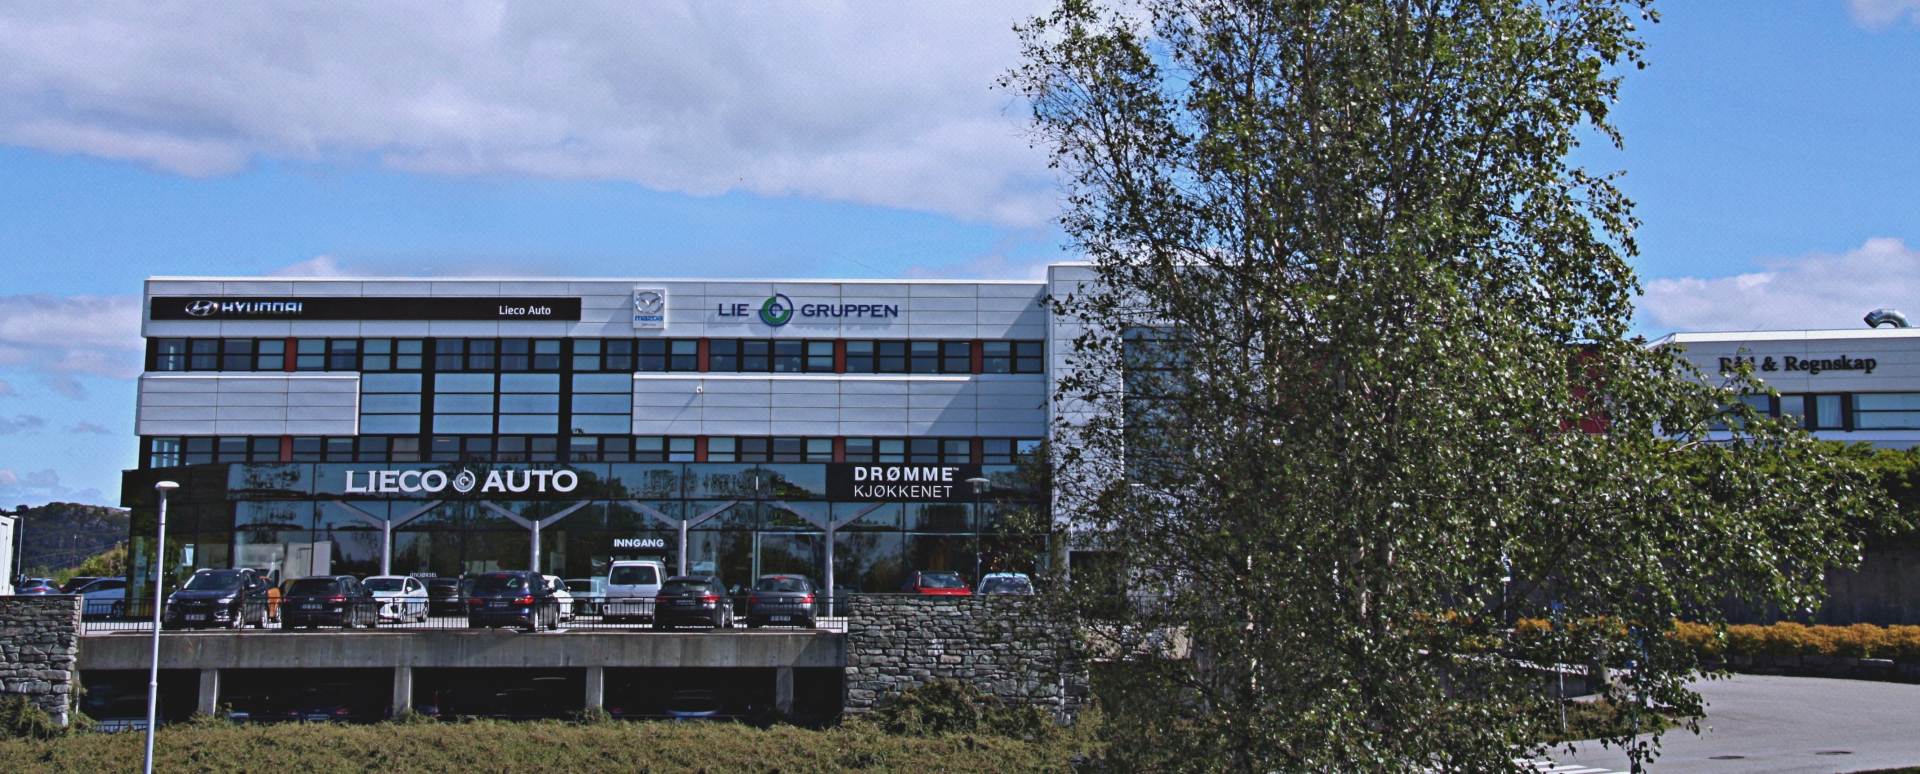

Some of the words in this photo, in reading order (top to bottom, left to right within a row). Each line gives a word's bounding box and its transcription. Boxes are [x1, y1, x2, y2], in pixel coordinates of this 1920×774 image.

[499, 305, 526, 315] Lieco
[527, 305, 552, 315] Auto
[718, 303, 749, 317] LIE
[801, 303, 899, 318] GRUPPEN
[1761, 356, 1778, 372] &
[1784, 354, 1877, 375] Regnskap
[345, 469, 446, 493] LIECO
[481, 469, 578, 493] AUTO
[854, 485, 953, 498] KJØKKENET
[613, 538, 665, 548] INNGANG
